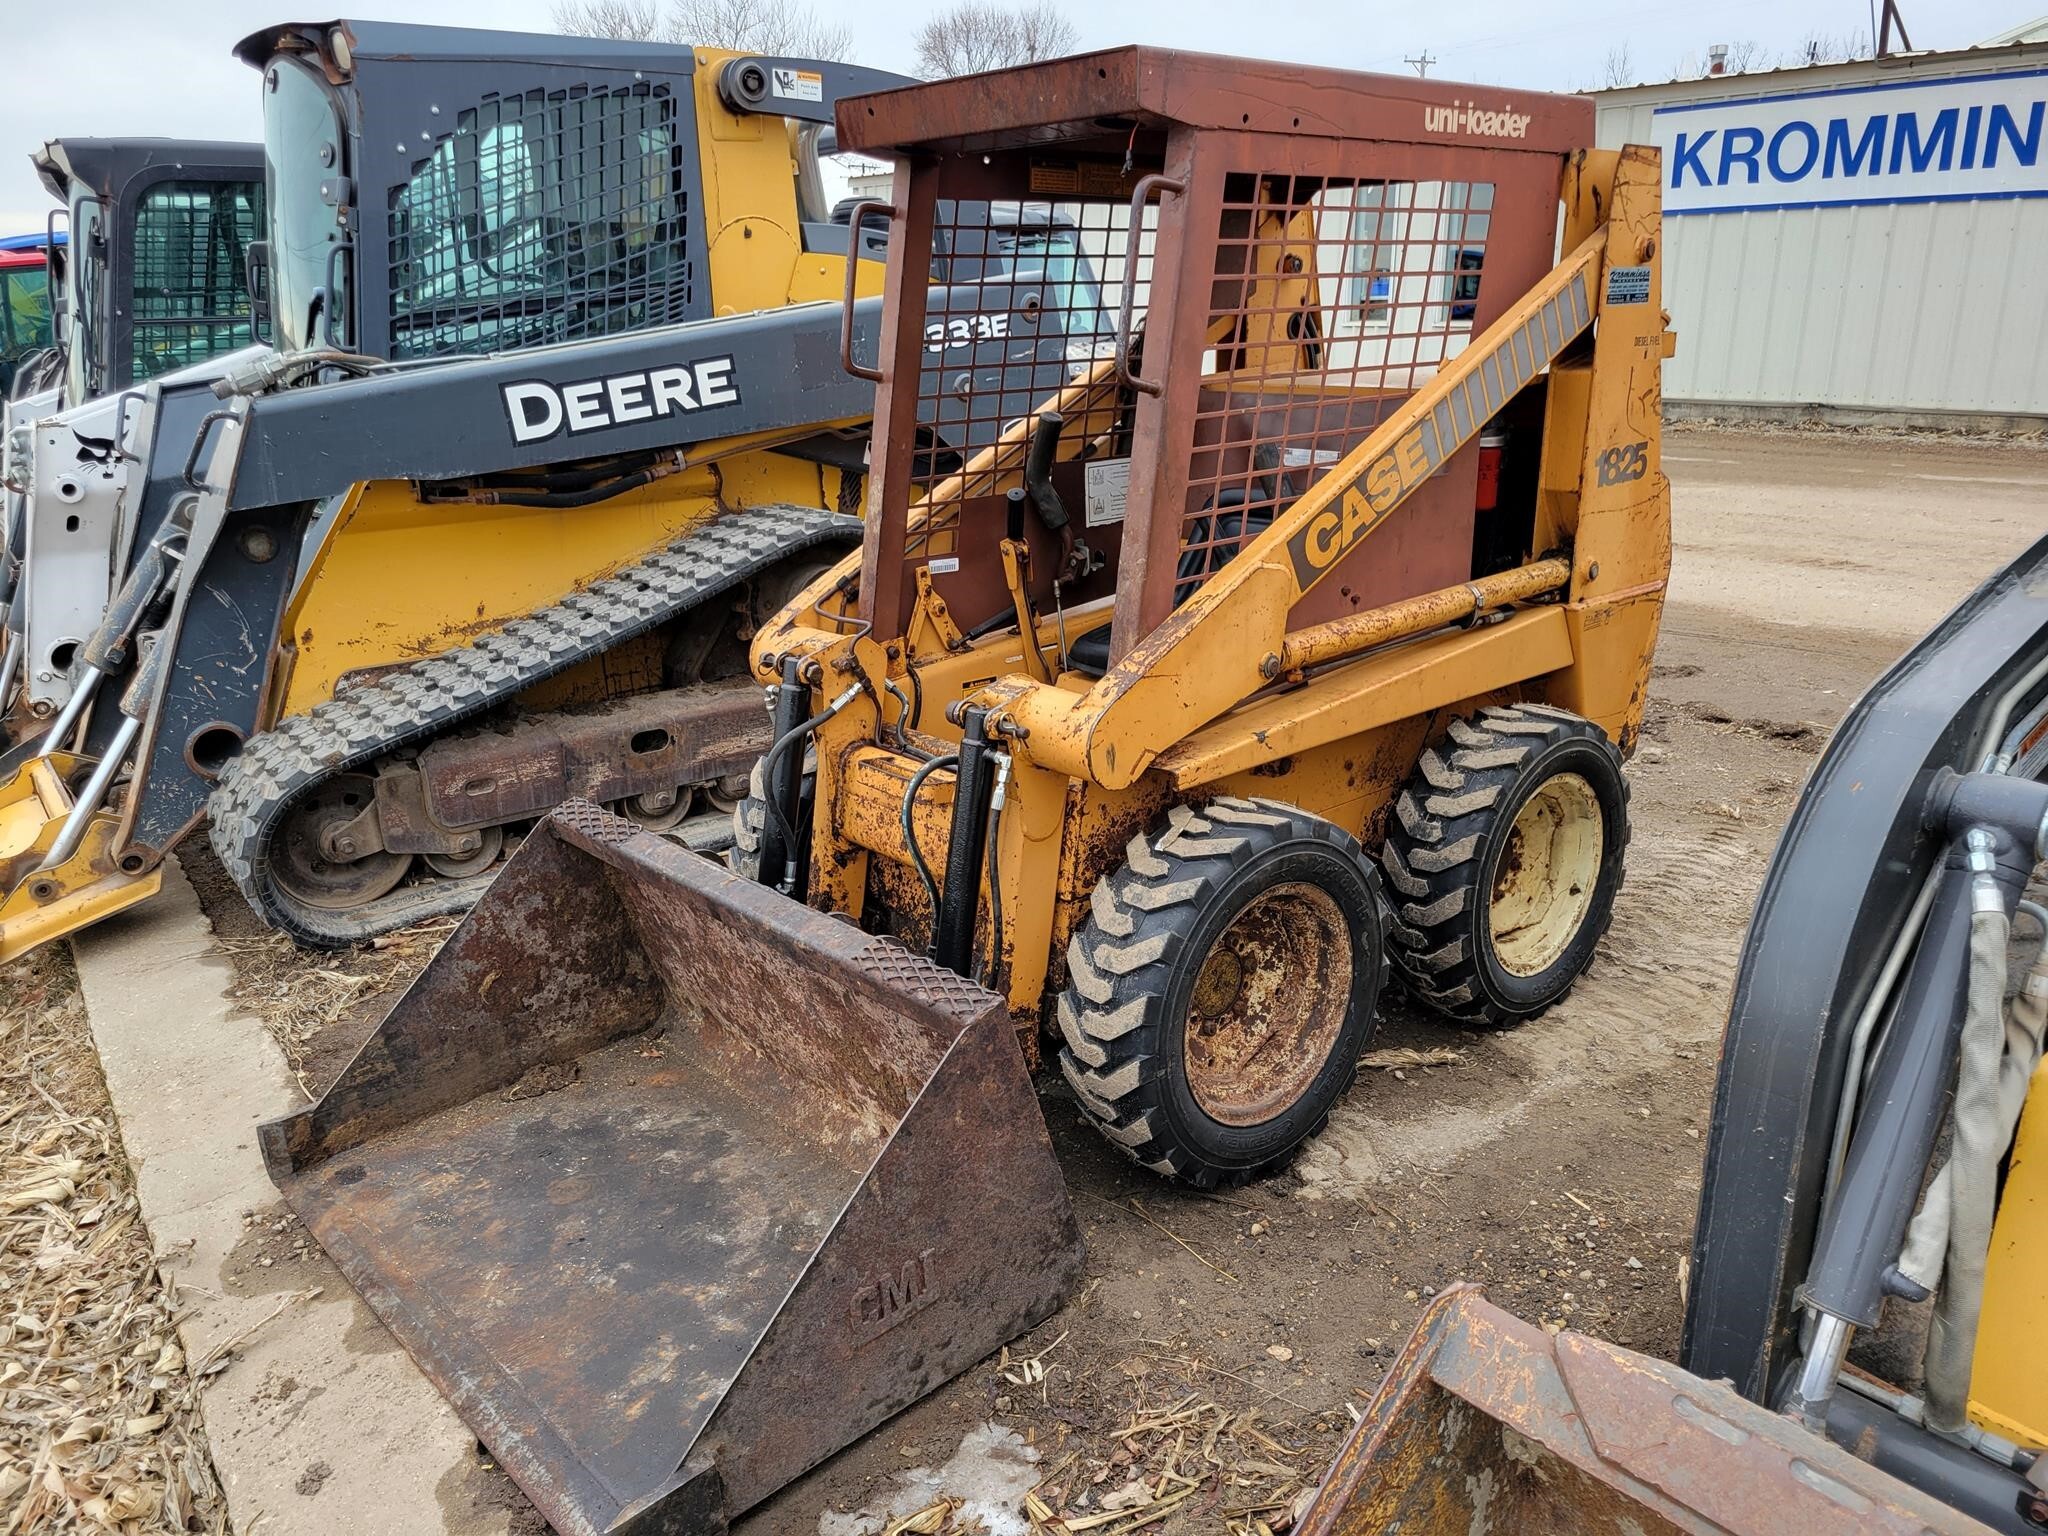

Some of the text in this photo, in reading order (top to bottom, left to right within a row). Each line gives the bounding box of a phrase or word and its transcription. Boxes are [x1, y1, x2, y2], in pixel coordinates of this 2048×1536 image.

[1671, 101, 2046, 189] KROMMIN
[926, 313, 1009, 353] 333E
[505, 359, 737, 441] DEERE
[1305, 424, 1429, 568] CASE
[1595, 441, 1649, 488] 1825
